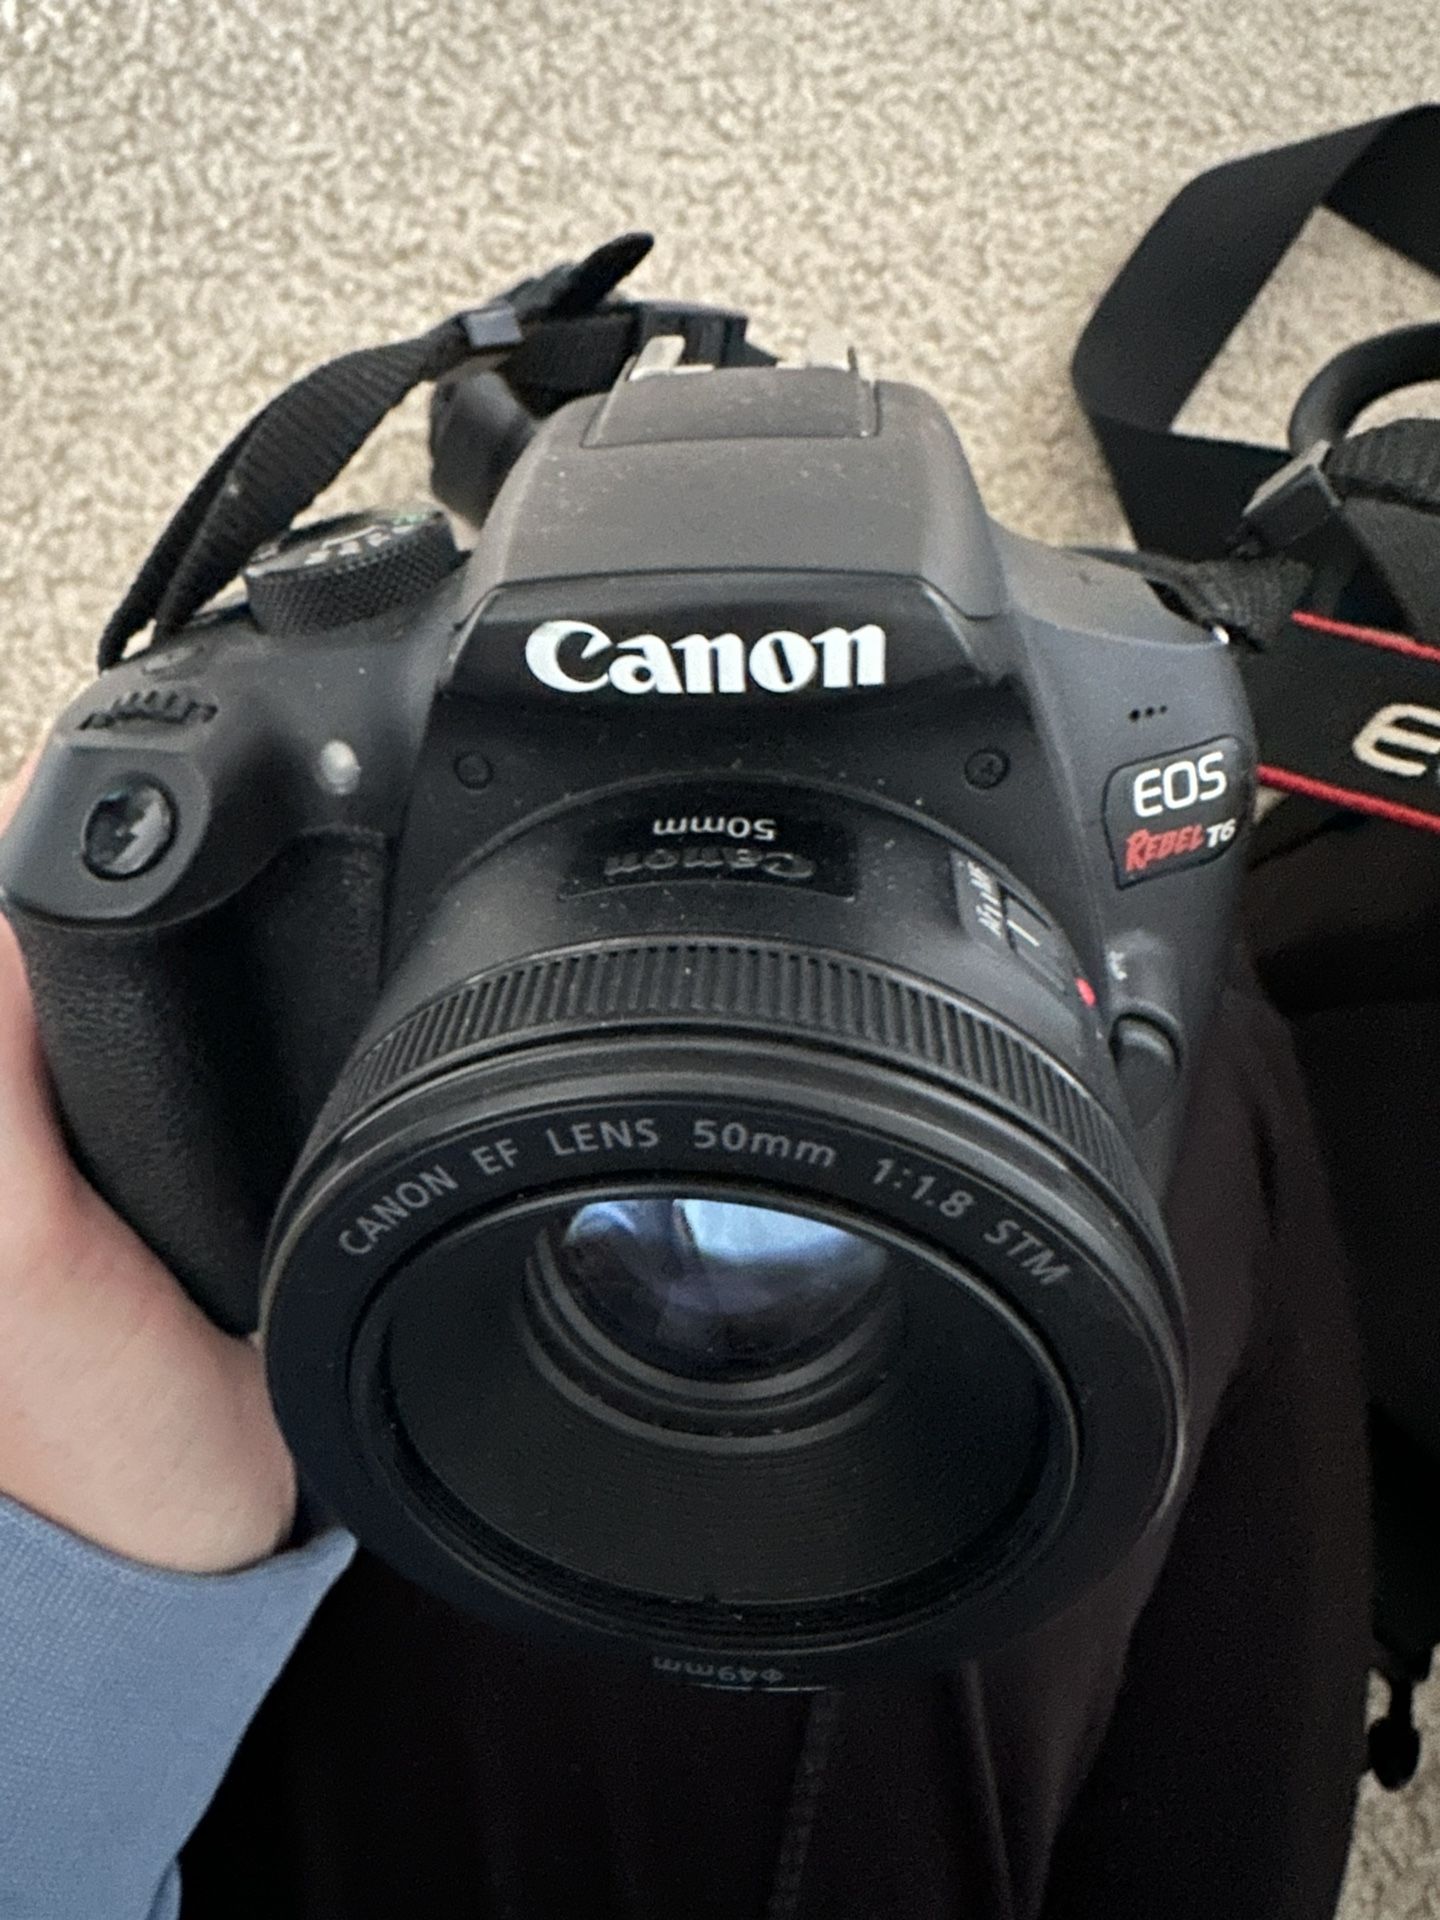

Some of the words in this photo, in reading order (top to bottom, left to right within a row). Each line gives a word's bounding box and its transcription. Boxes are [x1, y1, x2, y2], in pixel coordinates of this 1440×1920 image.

[525, 619, 886, 695] Canon
[1133, 750, 1228, 818] EOS
[652, 816, 778, 841] 50mm
[1125, 823, 1205, 872] REBEL
[1206, 818, 1237, 848] T6
[603, 847, 818, 879] Canon
[338, 1164, 459, 1255] CANON
[470, 1138, 519, 1176] EF
[545, 1117, 660, 1157] LENS
[692, 1119, 837, 1169] 50mm
[871, 1157, 975, 1219] 1:1.8
[983, 1219, 1073, 1286] STM
